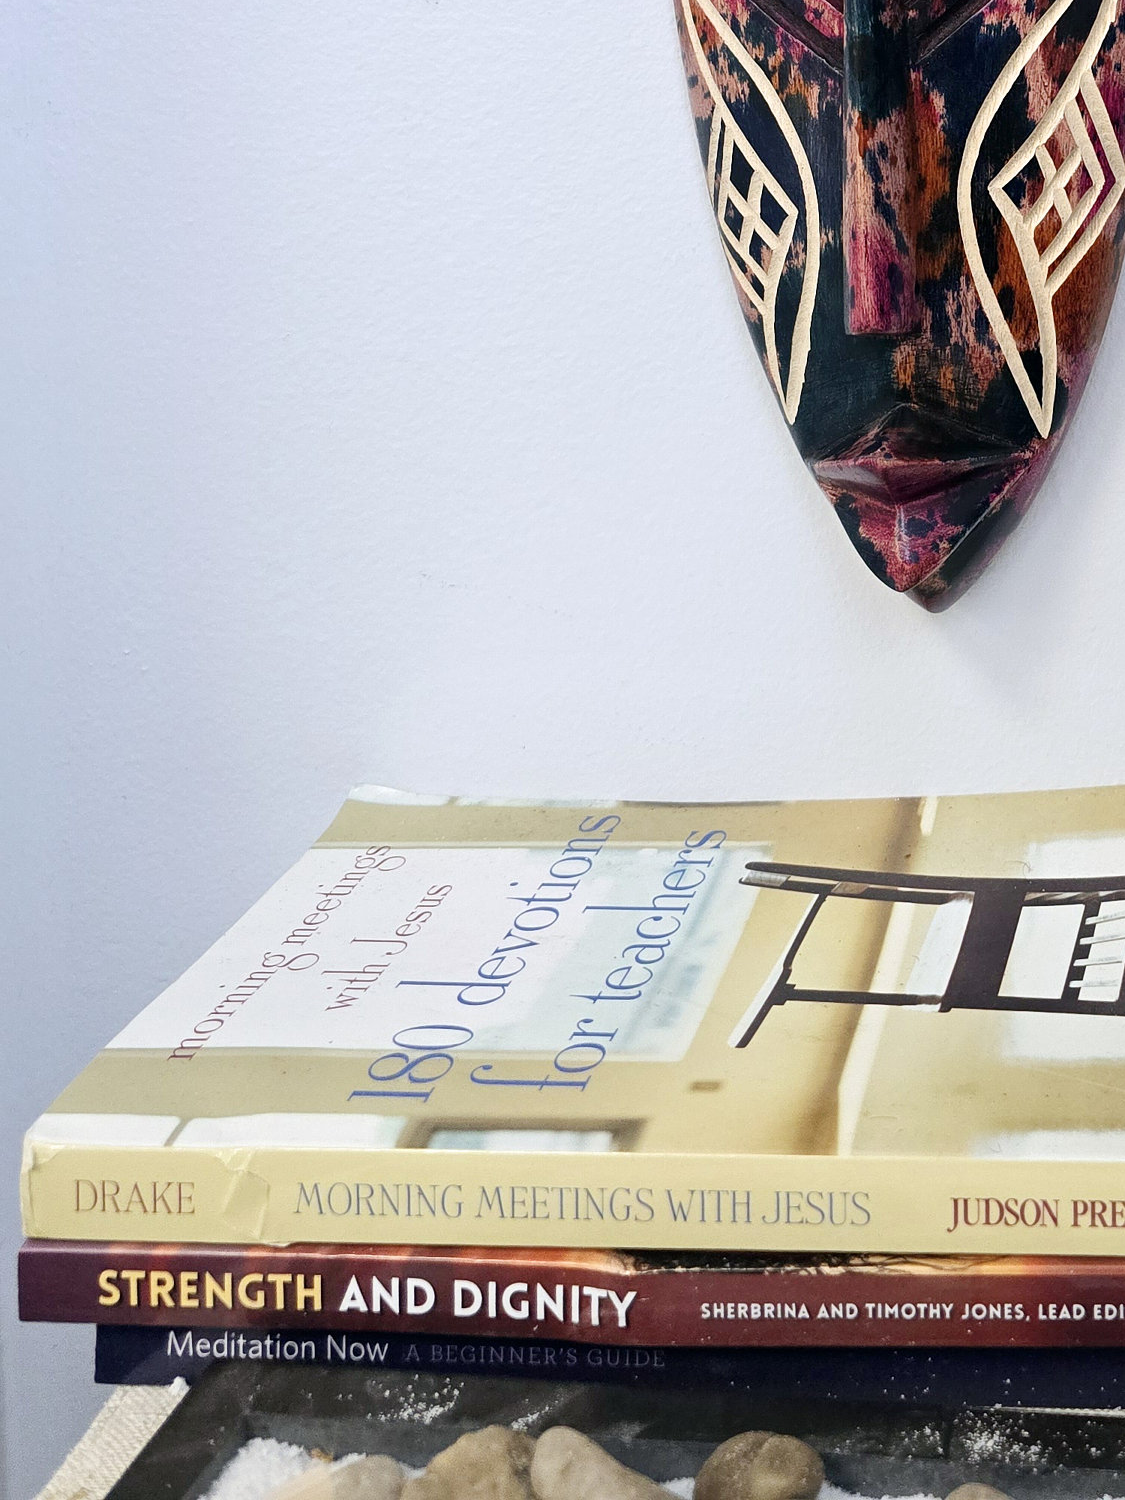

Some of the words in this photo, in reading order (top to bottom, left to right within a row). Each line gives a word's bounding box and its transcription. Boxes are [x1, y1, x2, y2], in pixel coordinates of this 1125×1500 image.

[350, 883, 454, 959] Jesus
[395, 813, 622, 1007] devotions
[168, 950, 320, 1061] morning
[283, 844, 407, 947] meetings
[468, 1017, 619, 1092] for
[570, 828, 728, 1005] teachers
[323, 963, 388, 1012] with
[347, 1023, 474, 1103] 180
[73, 1179, 195, 1215] DRAKE
[293, 1181, 462, 1222] MORNING
[474, 1183, 655, 1223] MEETINGS
[660, 1188, 753, 1224] WITH
[761, 1191, 872, 1227] JESUS
[947, 1196, 1060, 1232] JUDSON
[98, 1269, 323, 1313] STRENGTH
[338, 1274, 436, 1316] AND
[453, 1279, 638, 1328] DIGNITY
[699, 1301, 810, 1322] SHERBRINA
[816, 1302, 860, 1321] AND
[864, 1302, 954, 1322] TIMOTHY
[960, 1302, 1032, 1324] JONES,
[1037, 1303, 1086, 1322] LEAD
[166, 1331, 317, 1361] Meditation
[326, 1335, 389, 1363] Now
[404, 1344, 421, 1363] A
[430, 1345, 578, 1366] BEGINNER'S
[586, 1349, 666, 1369] GUIDE
